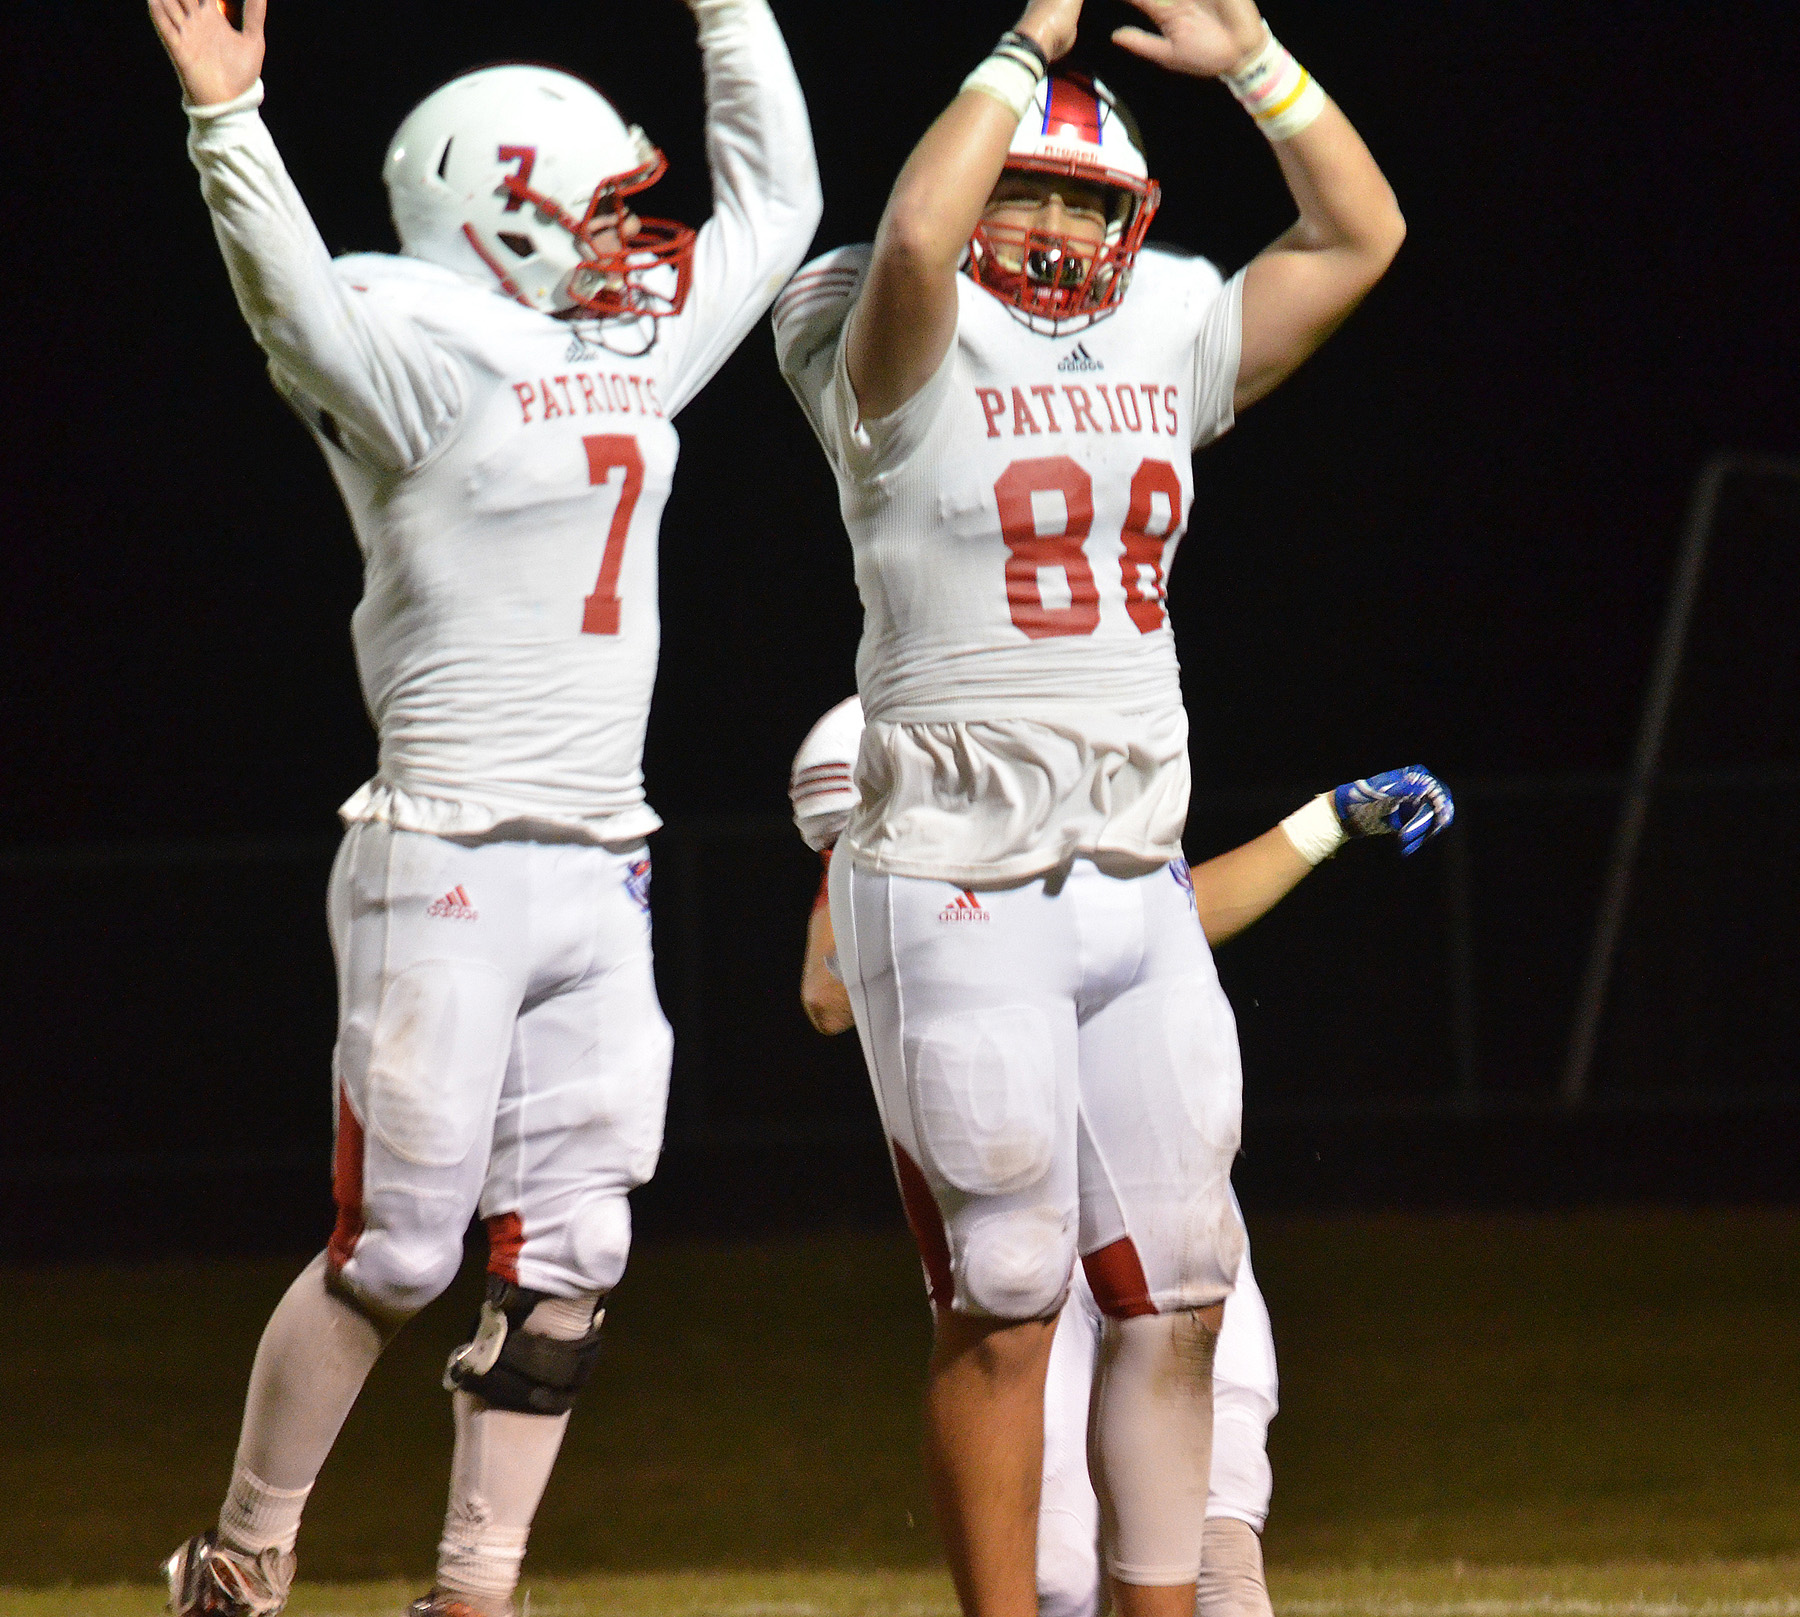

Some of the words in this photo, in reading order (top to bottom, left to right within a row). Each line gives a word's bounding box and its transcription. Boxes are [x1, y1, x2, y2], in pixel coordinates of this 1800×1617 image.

[498, 144, 537, 213] 7
[513, 373, 663, 424] PATRIOTS
[975, 383, 1179, 438] PATRIOTS
[581, 434, 645, 635] 7
[994, 455, 1182, 640] 88
[939, 908, 990, 922] adidas
